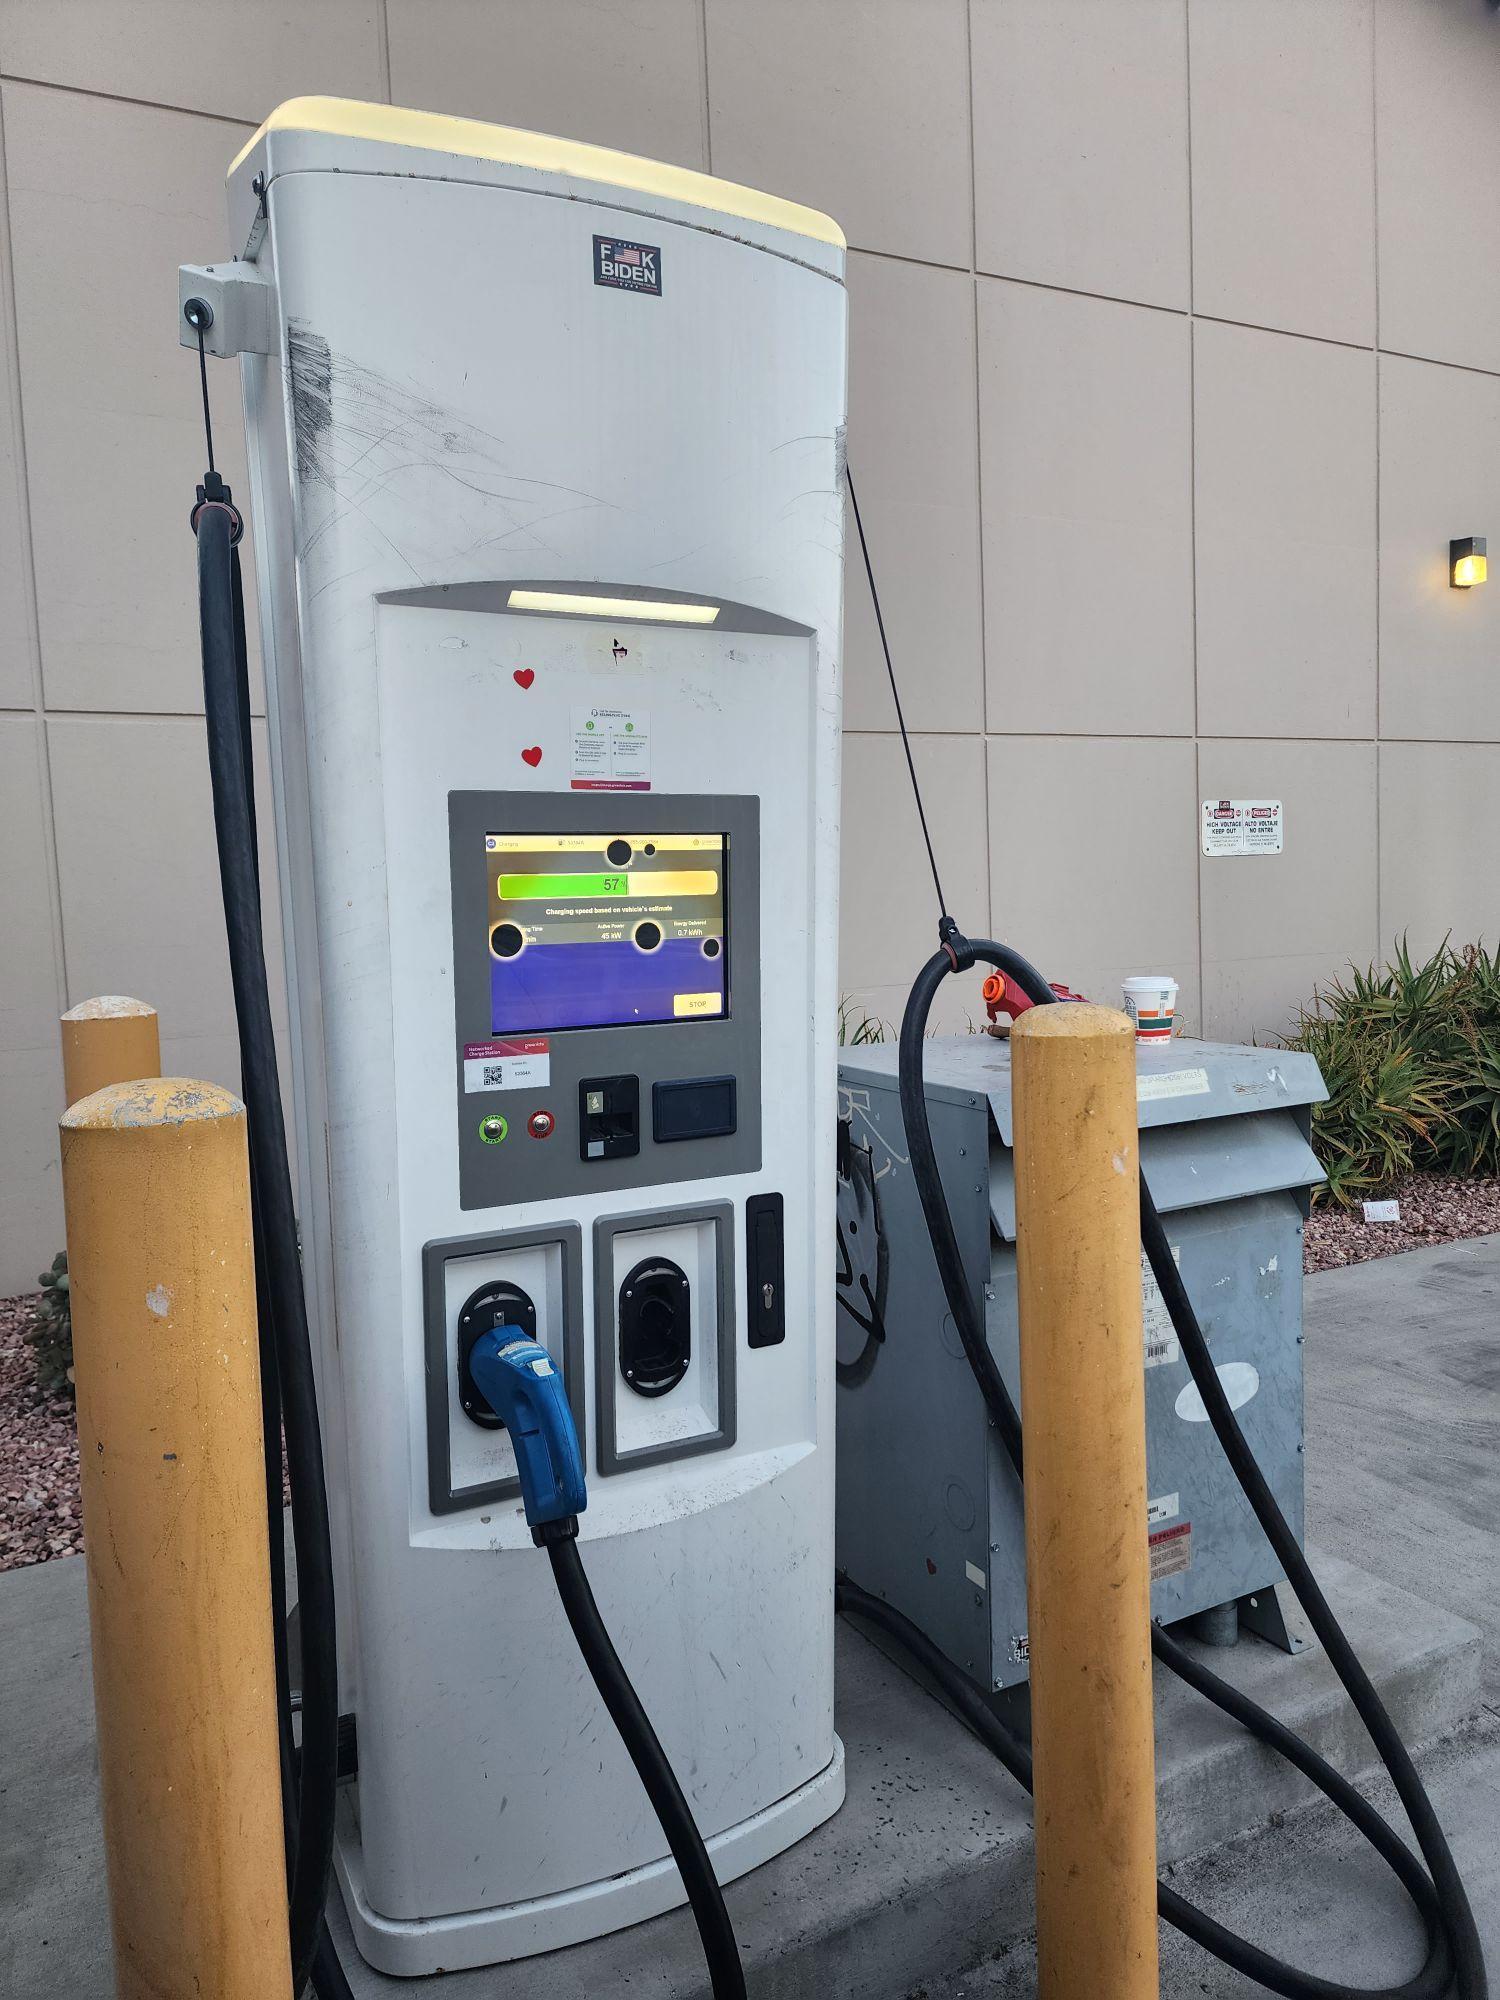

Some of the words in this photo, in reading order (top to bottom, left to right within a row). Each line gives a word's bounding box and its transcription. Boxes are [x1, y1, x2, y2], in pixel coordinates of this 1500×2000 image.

[601, 260, 656, 285] BIDEN
[603, 878, 619, 891] 57
[545, 908, 574, 916] Charging
[600, 932, 610, 940] 45
[689, 1000, 707, 1008] STOP
